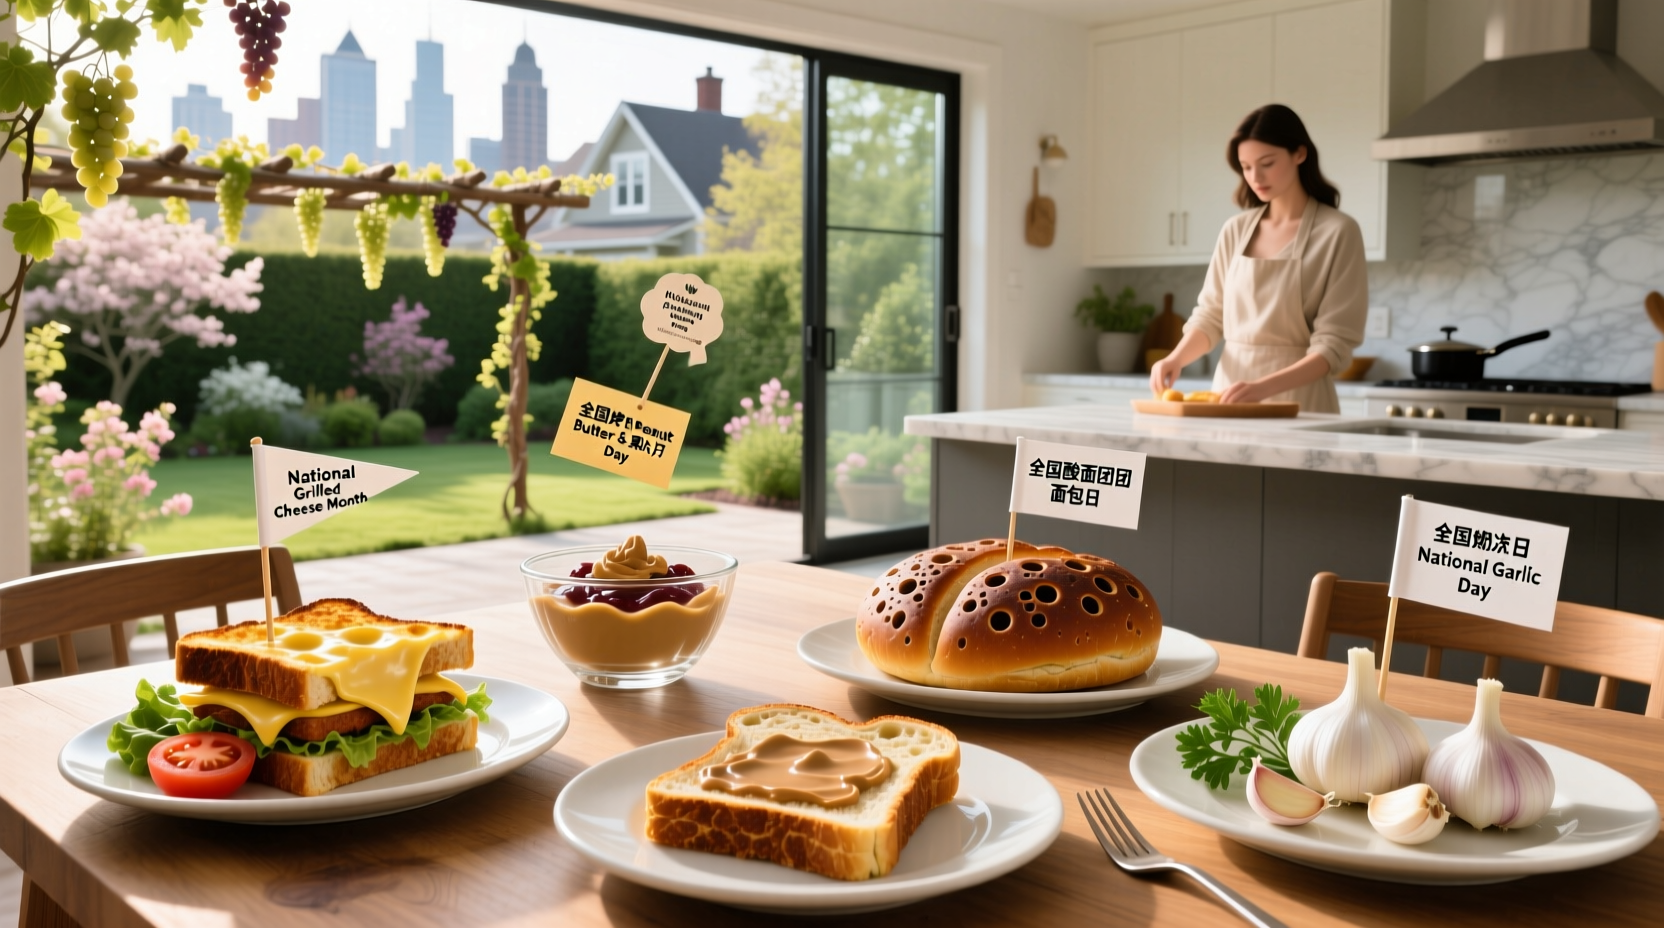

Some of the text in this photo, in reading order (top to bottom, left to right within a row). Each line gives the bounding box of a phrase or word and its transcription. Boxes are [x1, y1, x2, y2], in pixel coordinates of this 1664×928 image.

[603, 445, 629, 465] Day
[288, 464, 355, 485] National
[294, 482, 341, 500] Grilled
[1050, 483, 1100, 507] 面包日
[274, 491, 368, 518] Cheese Month
[1417, 546, 1542, 585] National Garlic
[1457, 577, 1492, 602] Day
